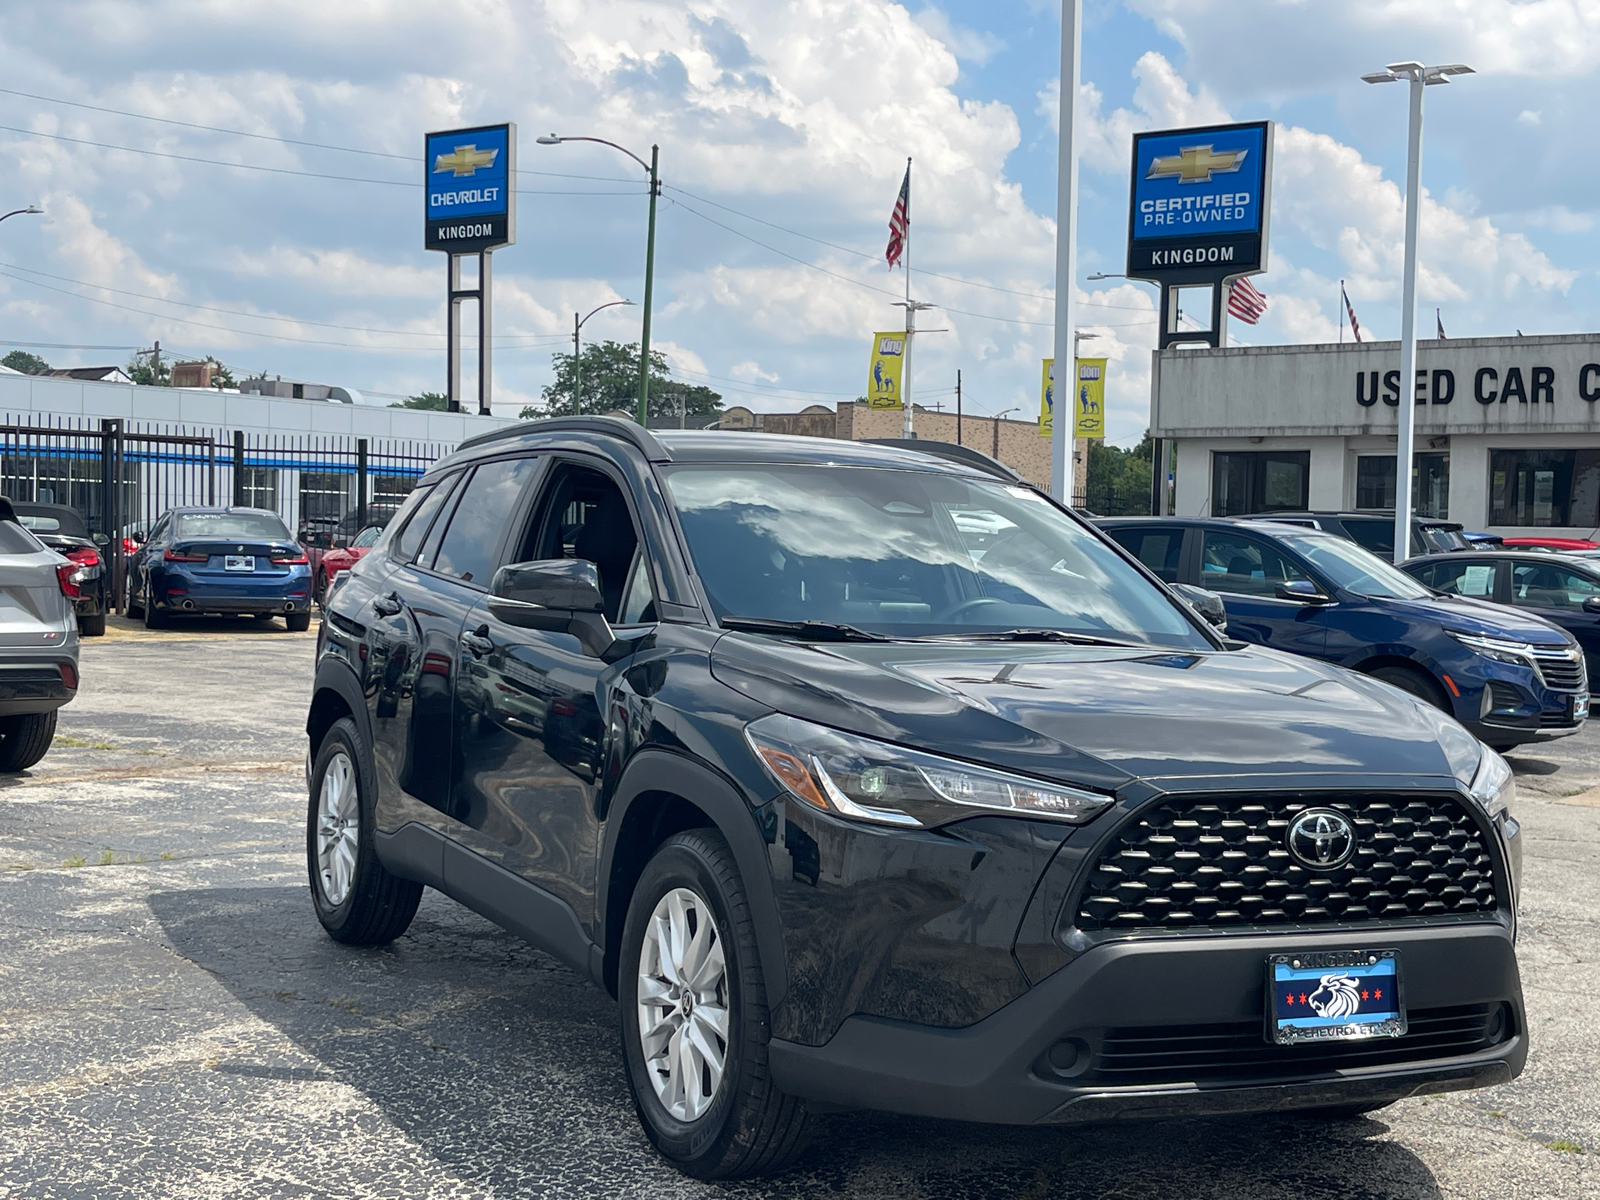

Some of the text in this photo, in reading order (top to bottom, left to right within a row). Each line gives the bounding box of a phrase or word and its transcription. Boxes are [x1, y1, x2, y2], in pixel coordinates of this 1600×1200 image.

[431, 187, 499, 207] CHEVROLET
[1140, 192, 1250, 213] CERTIFIED
[1144, 207, 1245, 226] PRE-OWNED
[438, 223, 492, 240] KINGDOM
[1152, 246, 1234, 265] KINGDOM
[879, 338, 903, 356] King
[1356, 369, 1455, 407] USED
[1474, 367, 1555, 405] CAR
